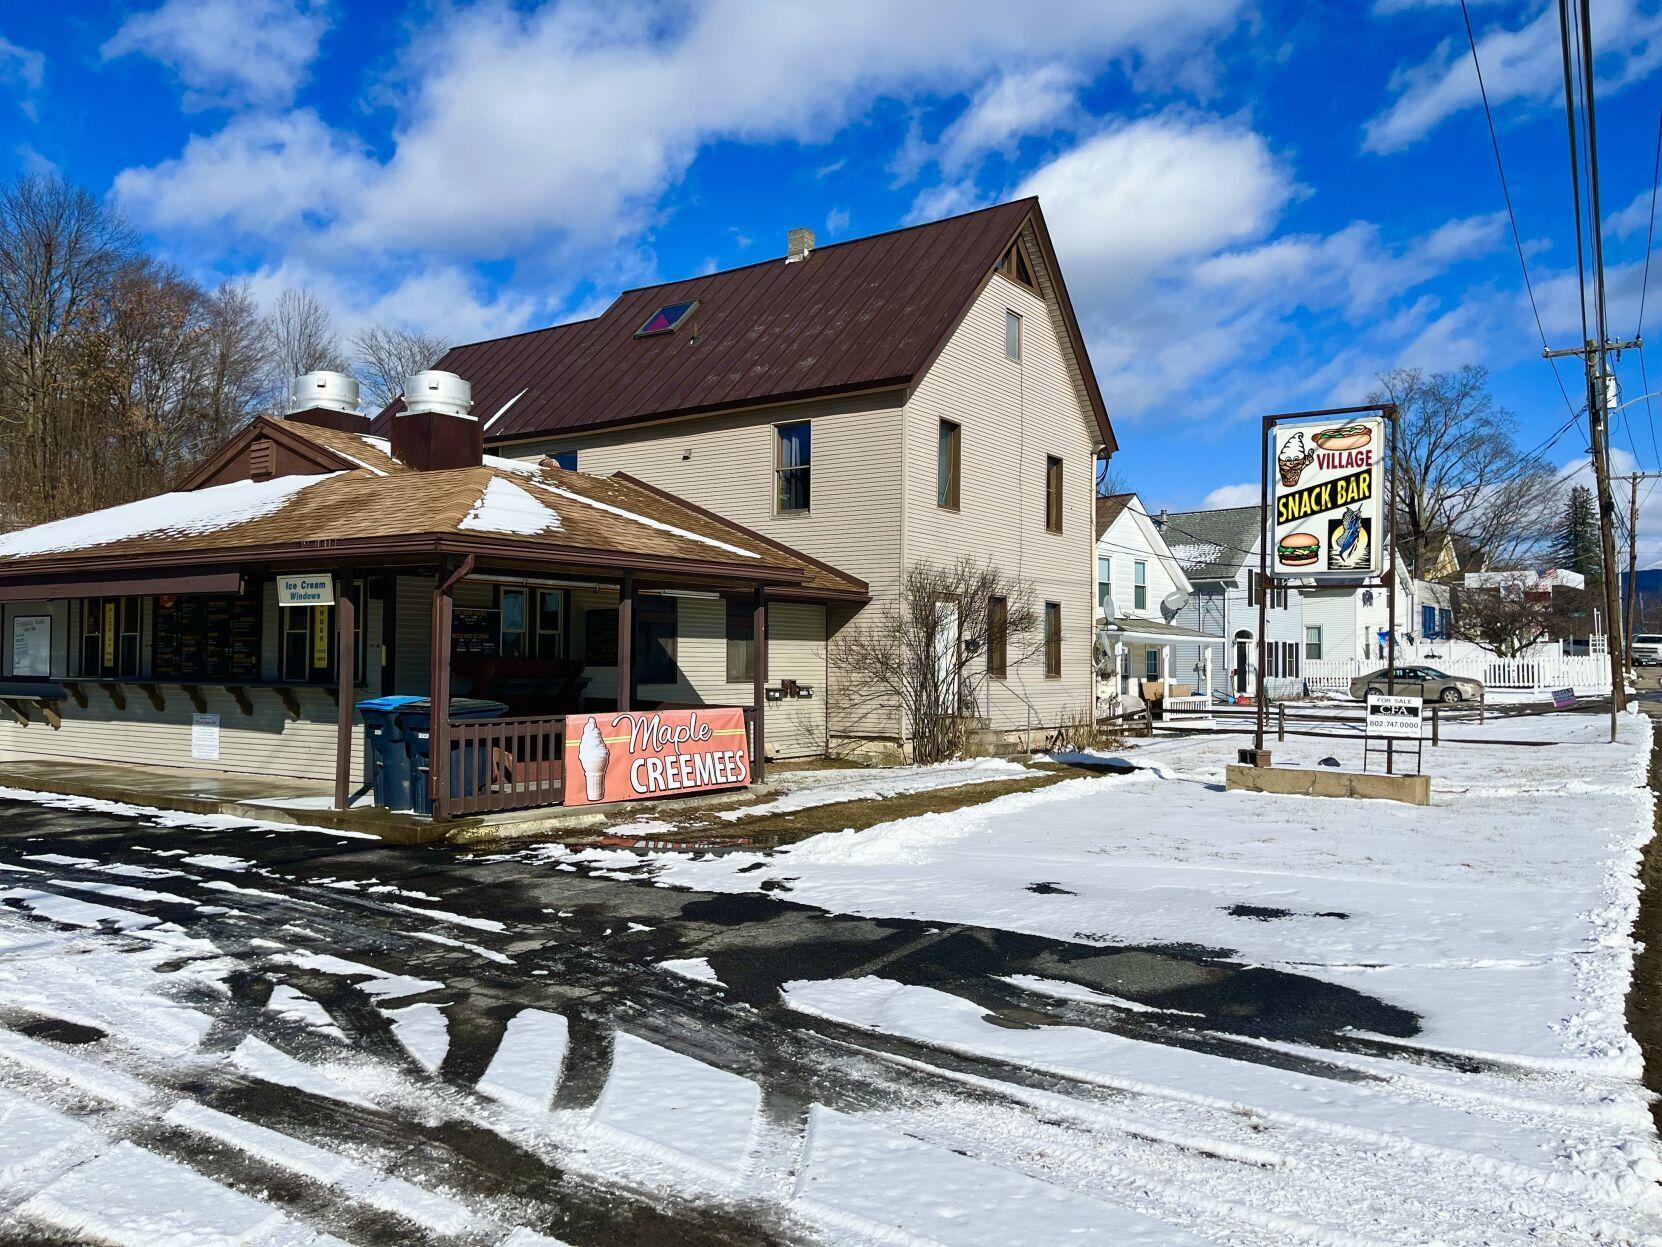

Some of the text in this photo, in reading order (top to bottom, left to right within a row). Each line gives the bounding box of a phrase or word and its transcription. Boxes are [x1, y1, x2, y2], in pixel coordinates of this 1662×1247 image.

[1317, 450, 1372, 470] VILLAGE
[1279, 473, 1370, 522] SNACK BAR
[285, 580, 326, 590] Ice Cream
[290, 592, 321, 601] Windows
[1380, 705, 1408, 714] CFA
[1369, 720, 1419, 729] 802.747.0000
[611, 711, 713, 755] Maple
[629, 749, 747, 794] CREEMEES
